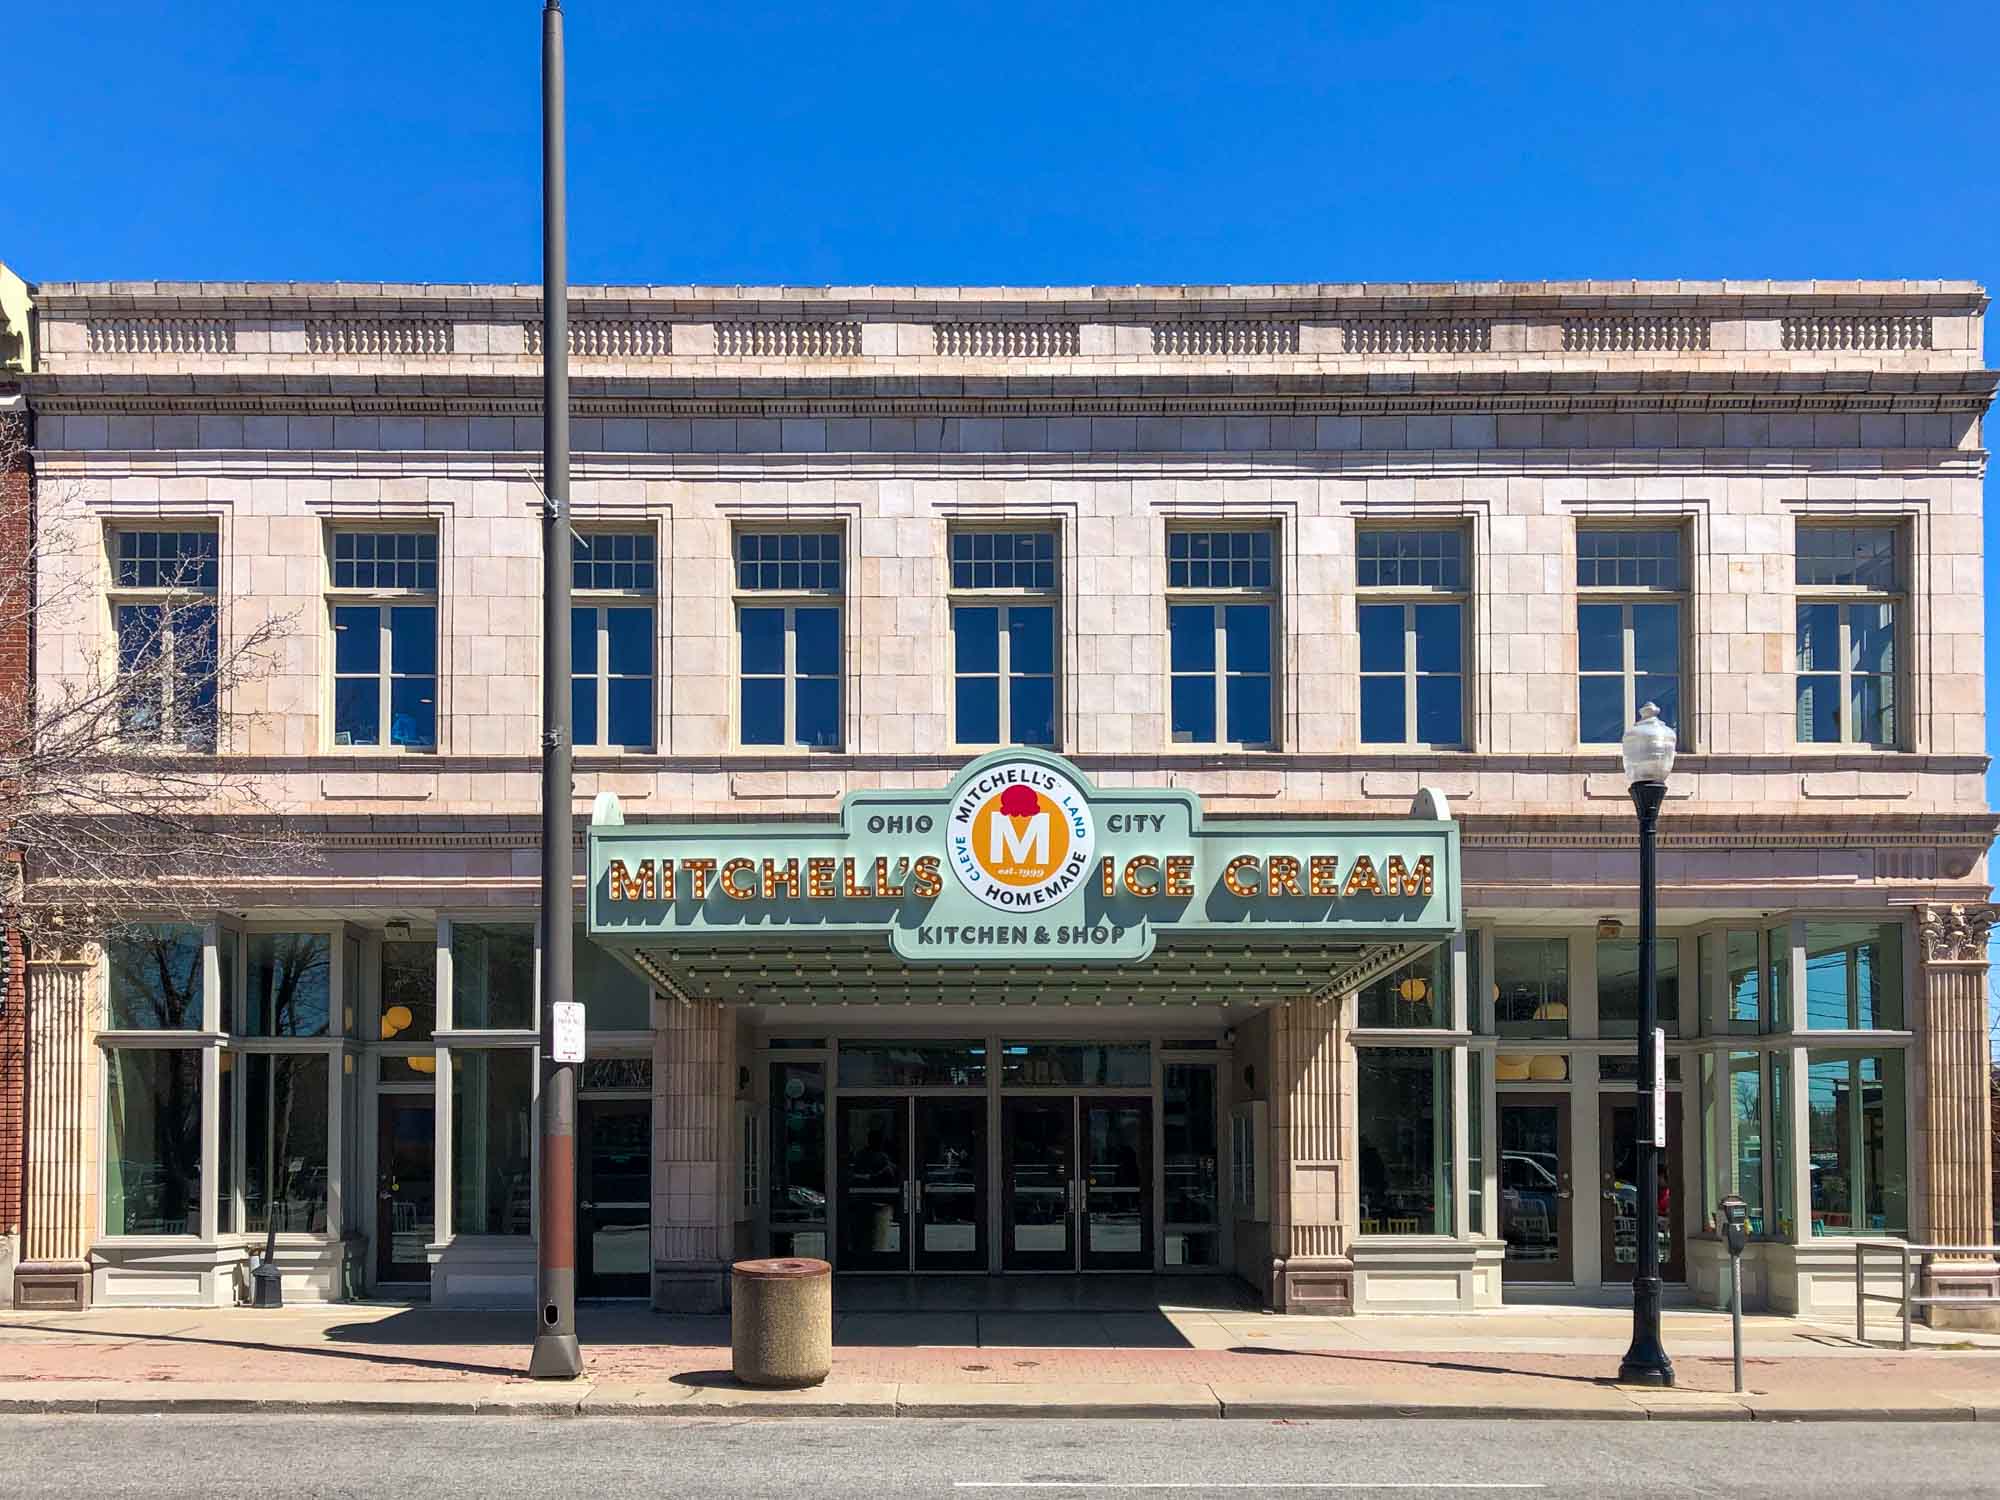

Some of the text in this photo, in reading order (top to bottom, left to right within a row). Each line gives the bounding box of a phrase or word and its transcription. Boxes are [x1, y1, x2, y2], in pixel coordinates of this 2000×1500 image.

[955, 769, 1057, 824] MITCHELL'S
[1062, 795, 1086, 839] LAND
[867, 814, 934, 834] OHIO
[989, 811, 1051, 865] M
[1106, 813, 1167, 833] CITY
[608, 856, 944, 901] MITCHELL'S
[955, 835, 981, 882] CLEVE
[985, 851, 1088, 906] HOMEMADE
[1101, 854, 1434, 897] ICE CREAM
[917, 926, 1126, 945] KITCHEN & SHOP
